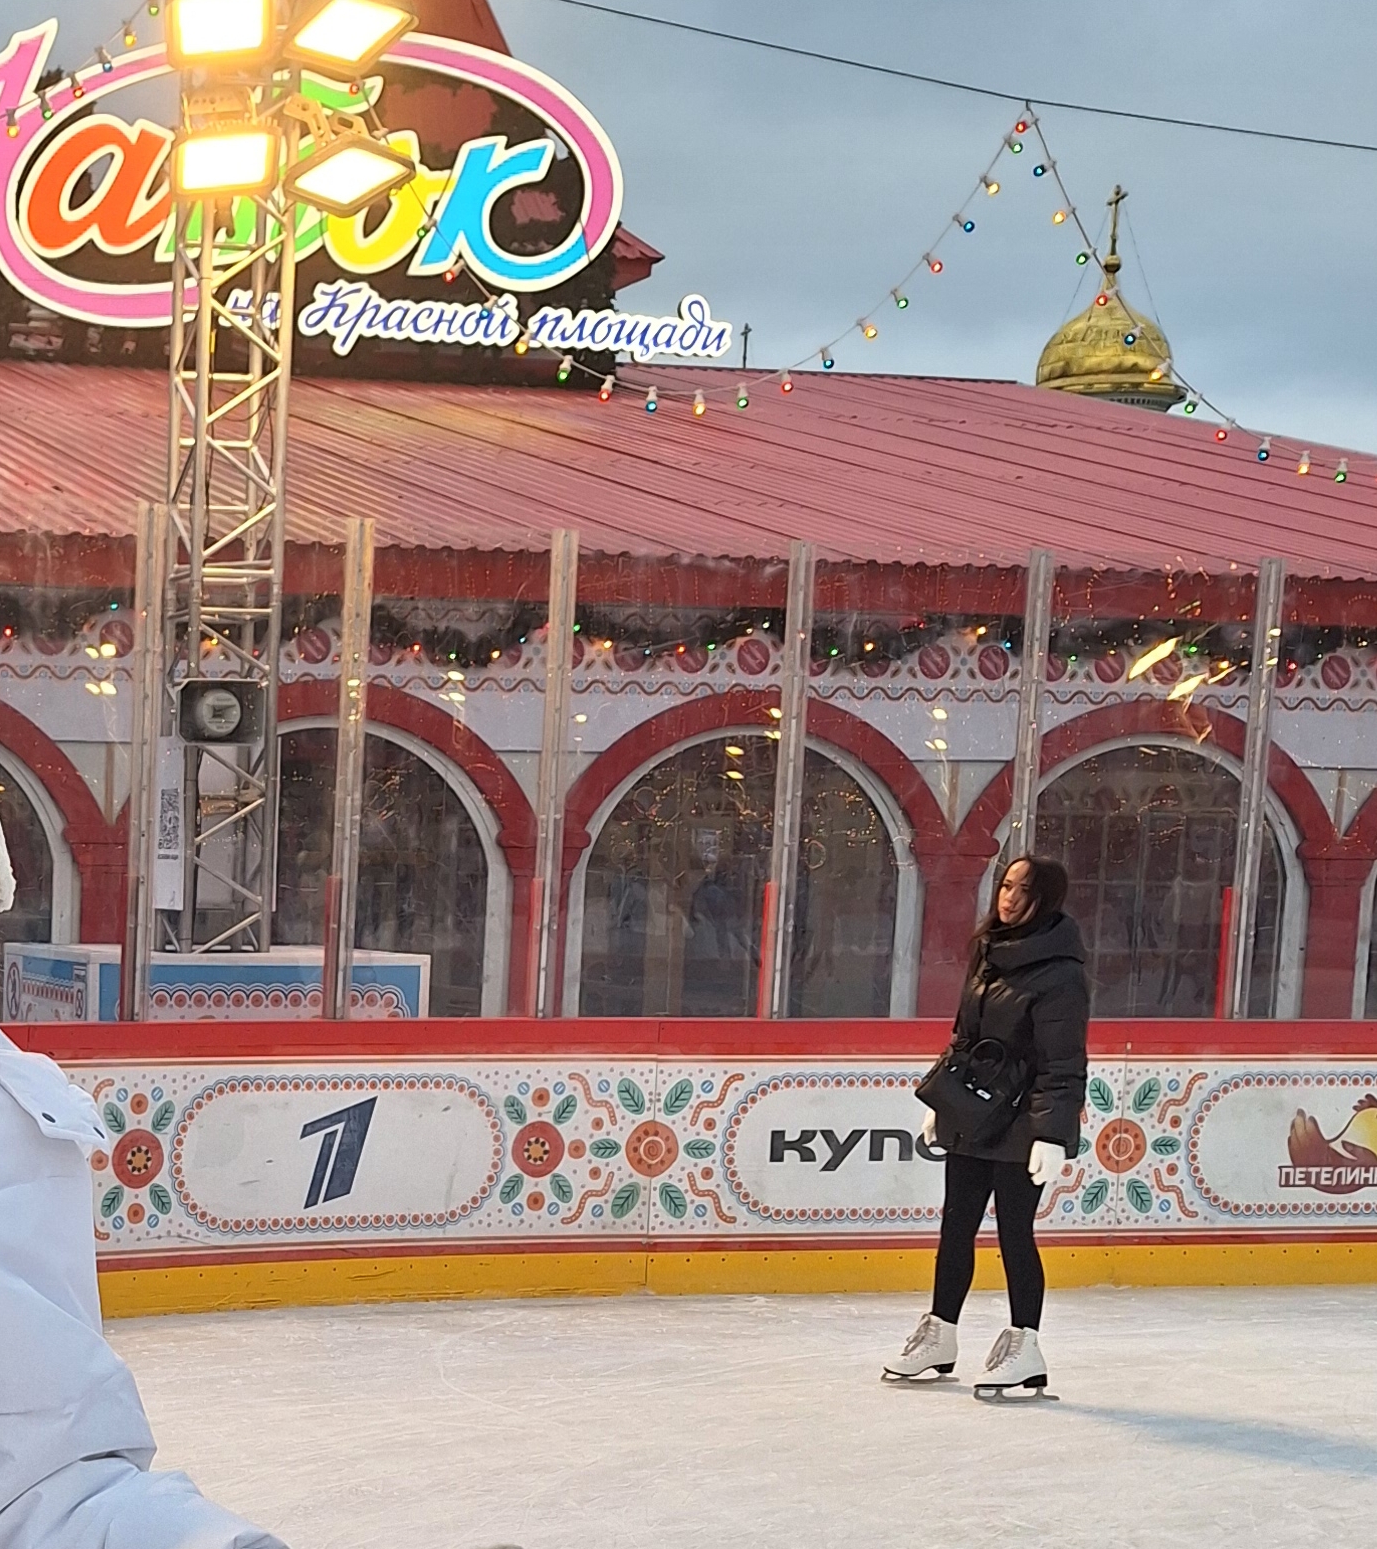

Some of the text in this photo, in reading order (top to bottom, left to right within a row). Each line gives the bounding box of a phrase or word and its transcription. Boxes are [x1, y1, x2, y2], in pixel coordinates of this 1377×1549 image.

[303, 285, 517, 354] Красной
[530, 296, 729, 357] площади
[1279, 1166, 1377, 1187] ПЕТЕЛИН
